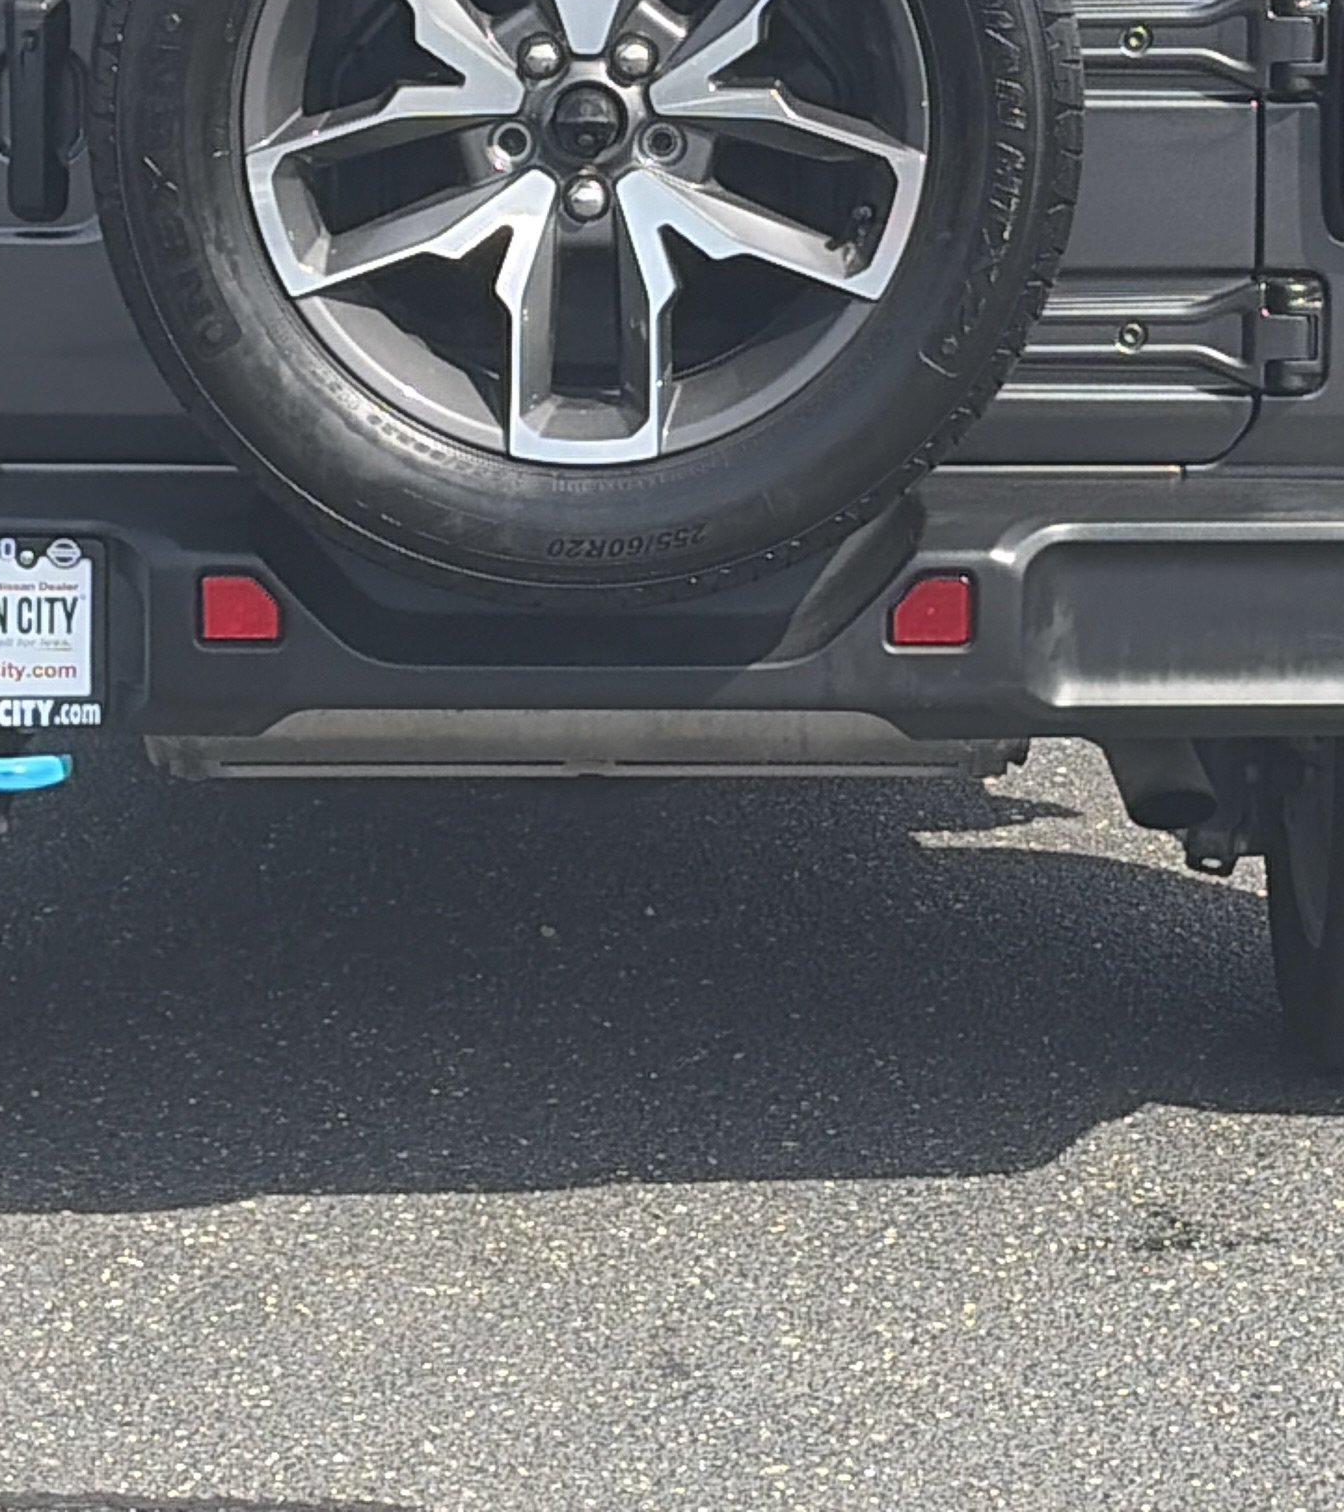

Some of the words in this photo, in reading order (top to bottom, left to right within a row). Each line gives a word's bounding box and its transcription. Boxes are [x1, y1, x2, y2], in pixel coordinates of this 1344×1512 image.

[546, 522, 707, 559] 255/60R20
[38, 580, 79, 591] Dealer
[17, 597, 78, 635] CITY
